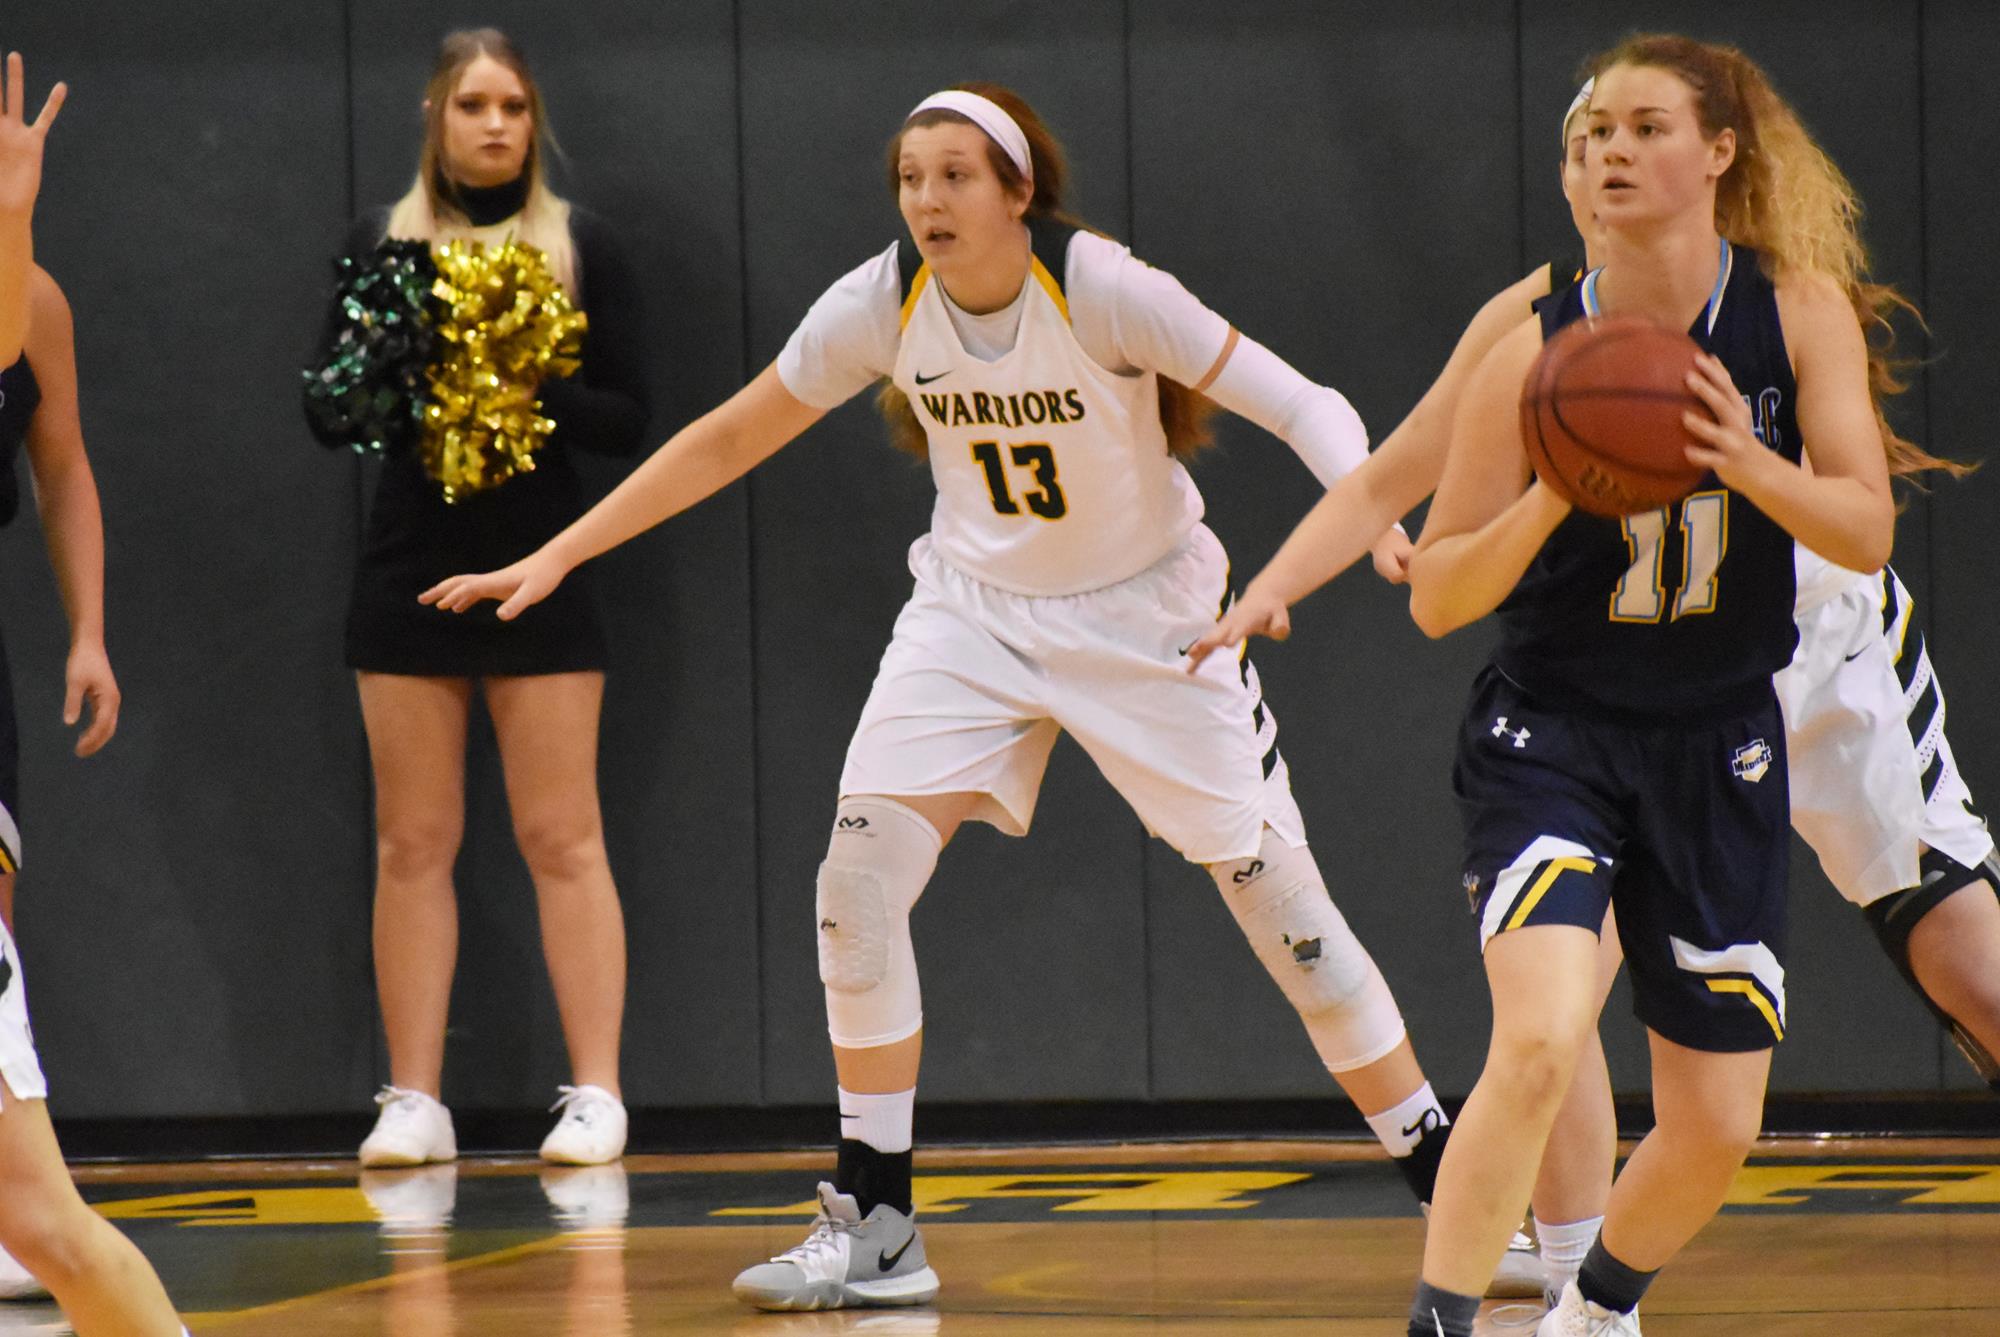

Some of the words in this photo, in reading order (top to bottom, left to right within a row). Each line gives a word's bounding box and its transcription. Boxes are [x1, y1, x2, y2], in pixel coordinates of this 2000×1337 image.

[920, 388, 1085, 427] WARRIORS
[969, 440, 1069, 521] 13
[1609, 490, 1728, 624] 11
